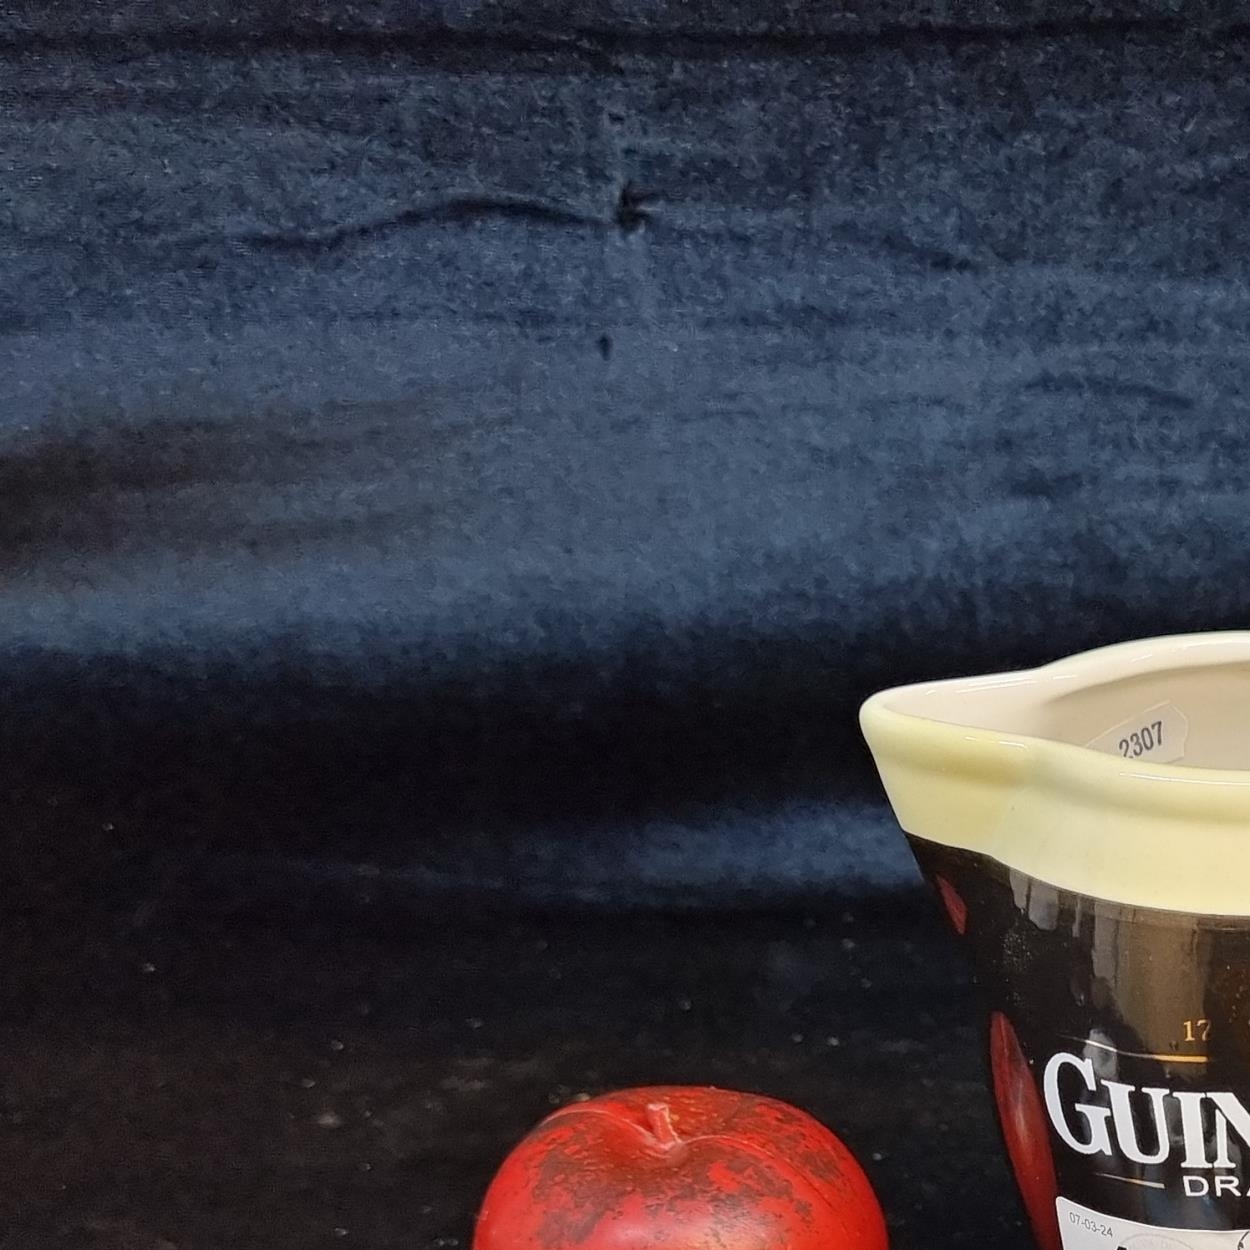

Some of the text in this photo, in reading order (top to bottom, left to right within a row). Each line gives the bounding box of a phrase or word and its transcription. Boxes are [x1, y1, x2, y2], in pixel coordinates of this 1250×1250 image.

[1119, 720, 1163, 758] 2307
[1183, 1019, 1211, 1042] 17
[1069, 1211, 1114, 1239] 07-03-24
